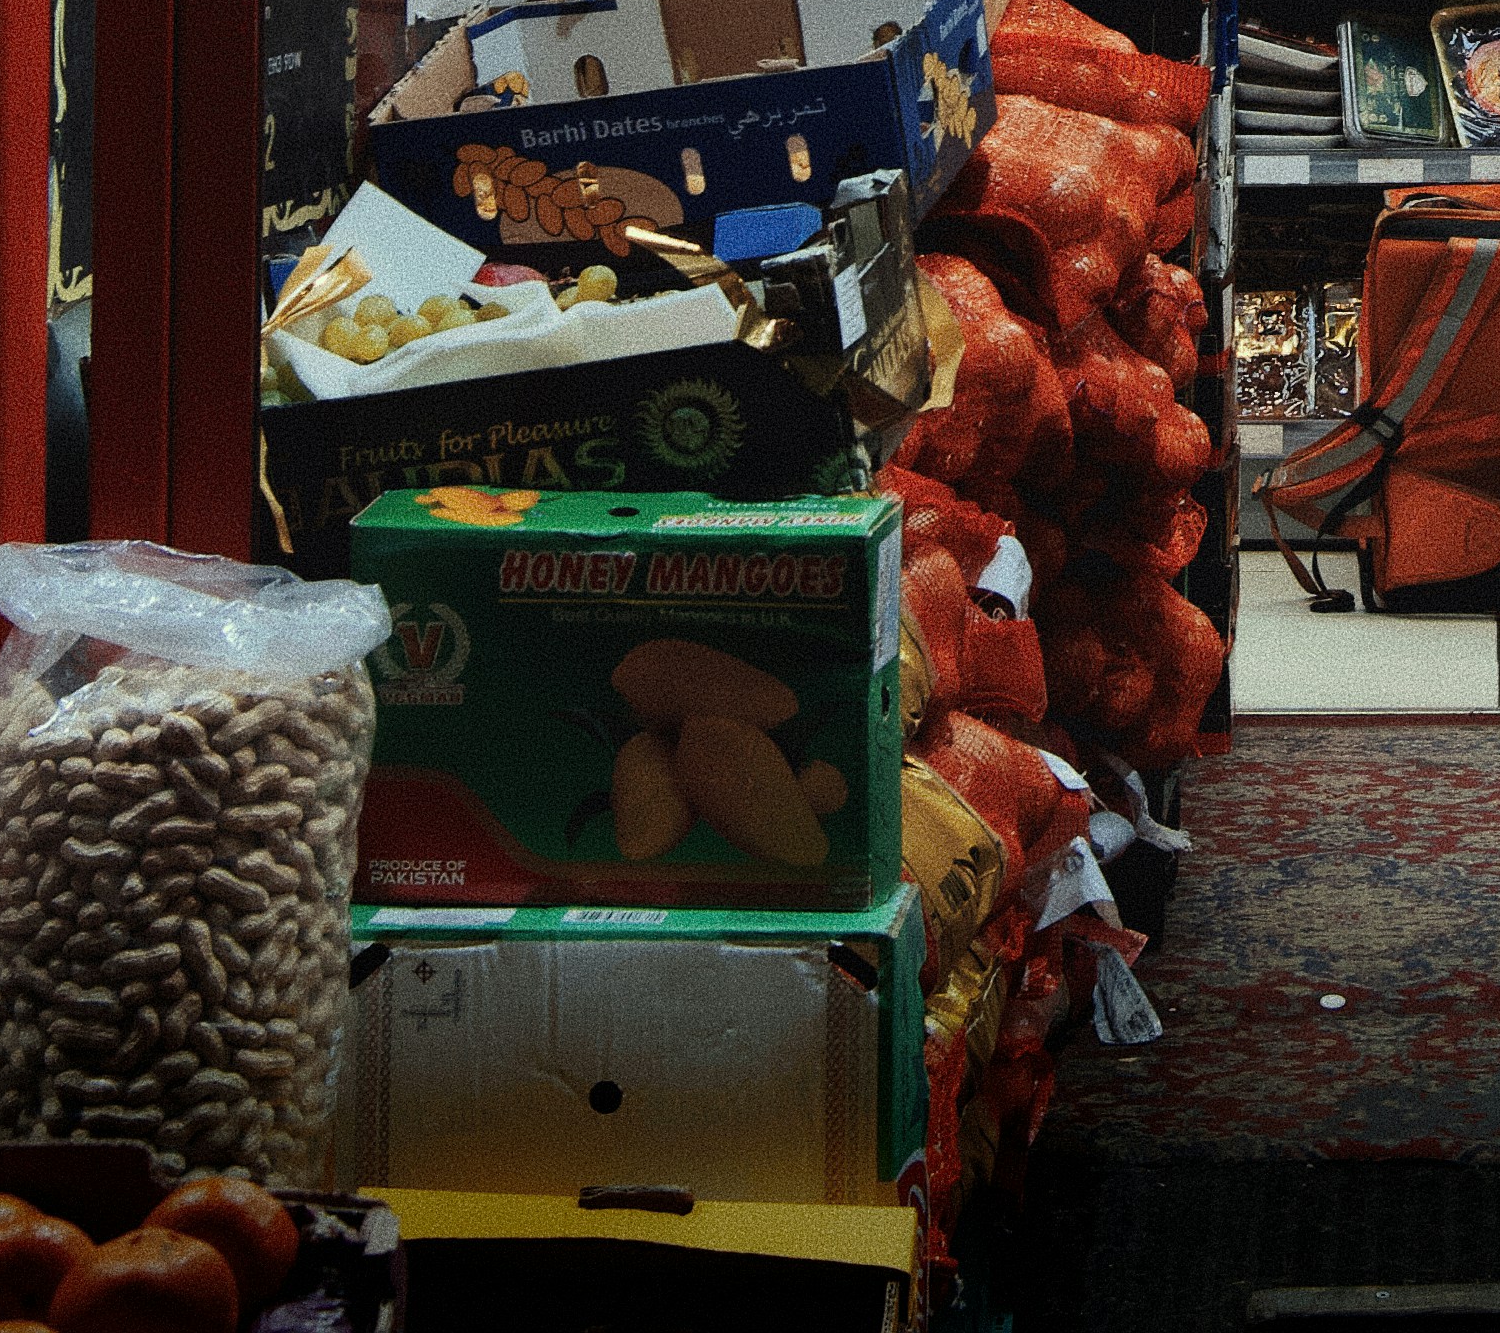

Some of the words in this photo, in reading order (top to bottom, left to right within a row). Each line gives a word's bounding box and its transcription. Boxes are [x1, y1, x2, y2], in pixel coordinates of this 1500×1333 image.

[520, 121, 587, 150] Barhi
[593, 114, 663, 141] Dates
[666, 111, 725, 131] branches
[338, 439, 424, 471] Fruits
[438, 428, 482, 460] for
[488, 414, 616, 450] Pleasure
[657, 515, 778, 527] MANGOES
[499, 549, 637, 594] HONEY
[646, 552, 847, 599] MANGOES
[368, 860, 443, 871] PRODUCE
[445, 860, 467, 870] OF
[370, 871, 465, 886] PAKISTAN
